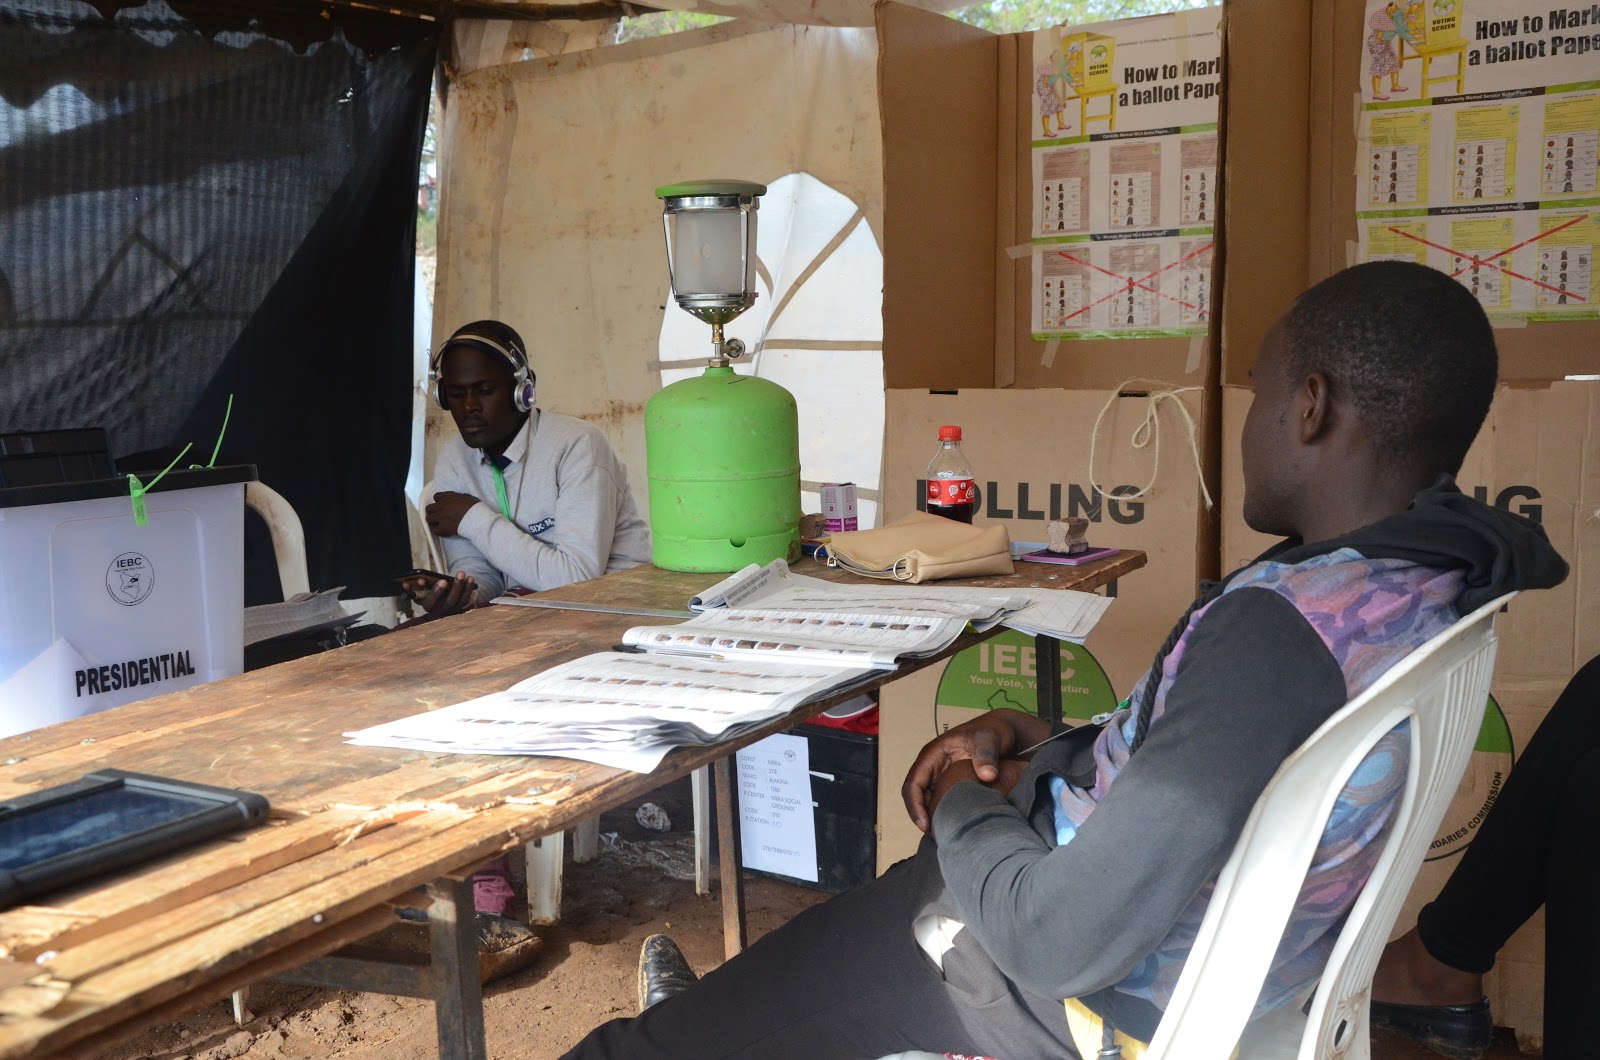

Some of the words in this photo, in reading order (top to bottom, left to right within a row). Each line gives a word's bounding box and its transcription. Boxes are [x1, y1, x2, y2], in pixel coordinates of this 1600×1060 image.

[1431, 23, 1456, 32] SCREEN
[1432, 16, 1456, 25] VOTING
[1476, 20, 1518, 40] How
[1523, 16, 1542, 34] to
[1469, 49, 1480, 66] a
[1486, 40, 1546, 64] ballot
[1551, 34, 1600, 55] Pape
[1124, 67, 1158, 84] How
[1162, 64, 1177, 79] to
[1119, 92, 1128, 107] a
[1133, 85, 1179, 105] ballot
[916, 480, 1145, 524] LLING
[116, 557, 142, 568] IEBC
[75, 650, 195, 697] PRESIDENTIAL
[970, 675, 993, 686] Your
[997, 678, 1024, 690] Vote,
[1062, 685, 1089, 694] uture
[772, 803, 795, 811] GROUNDS
[1429, 827, 1468, 850] NDARIES
[1467, 771, 1503, 829] COMMISSION
